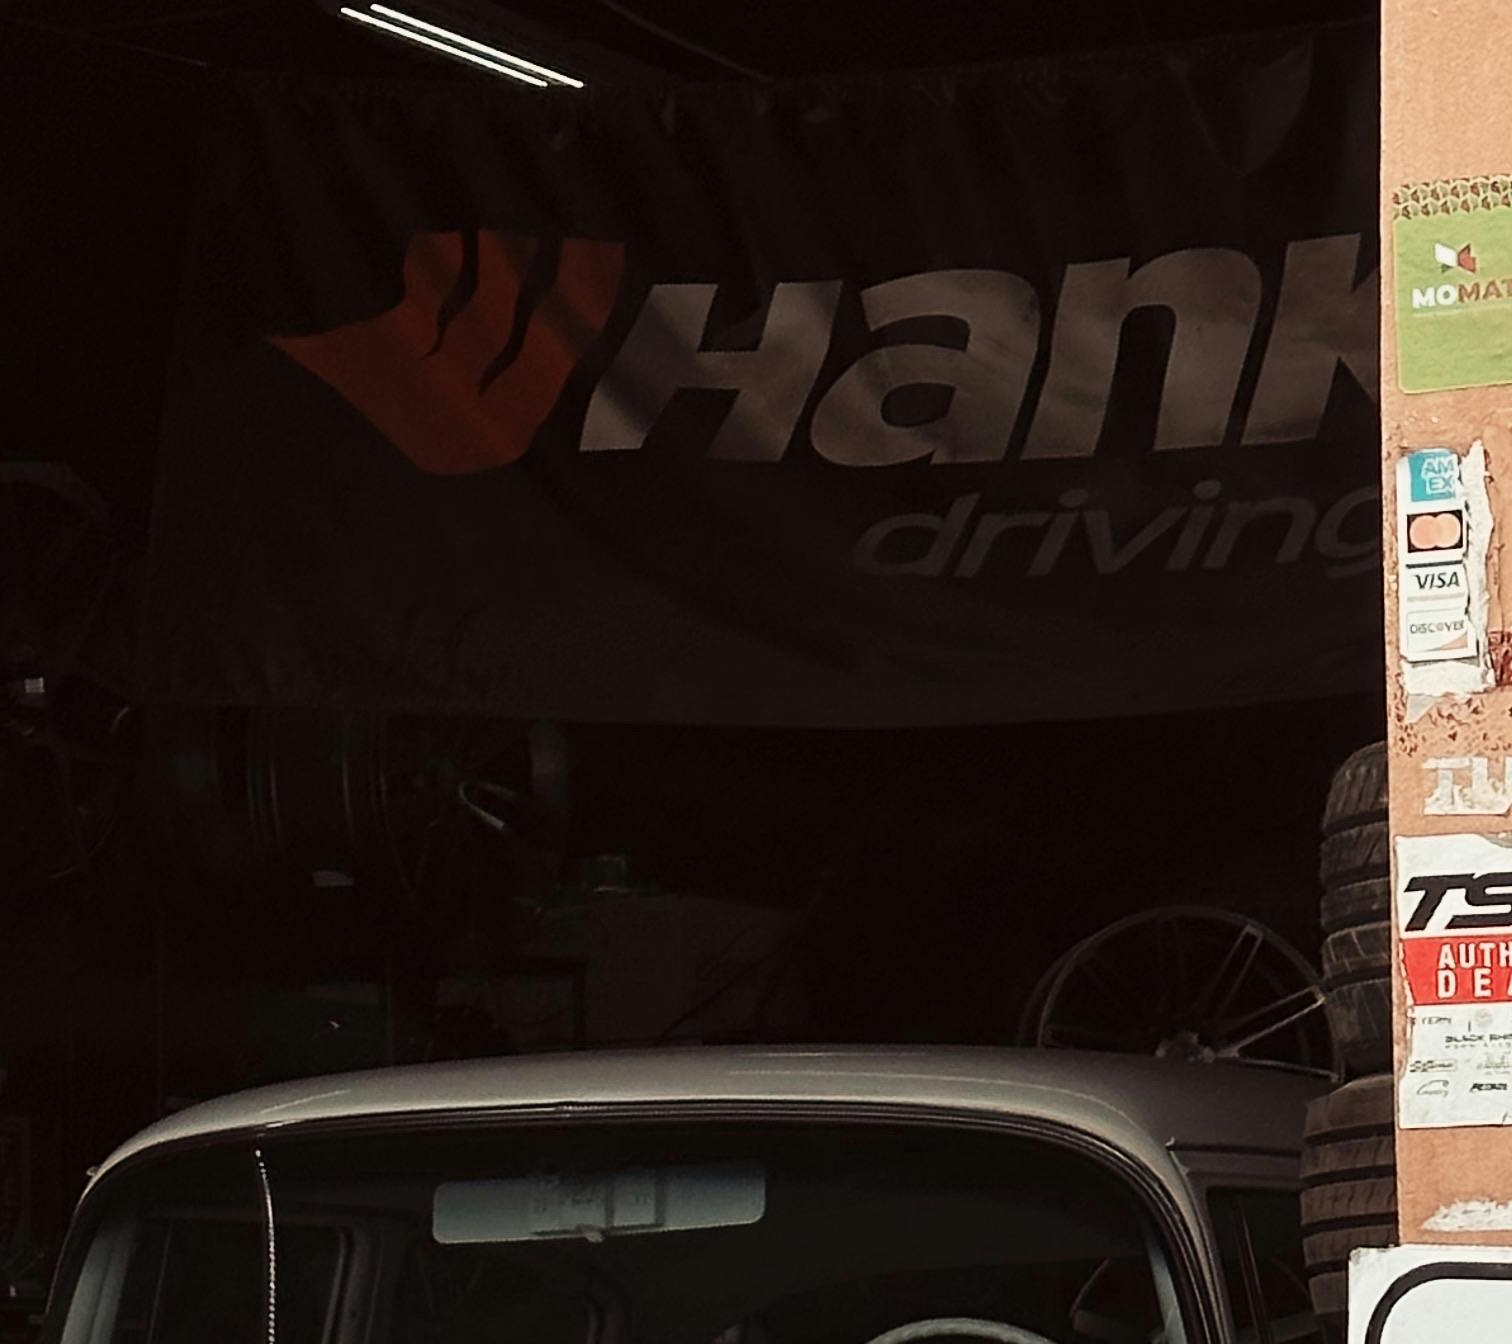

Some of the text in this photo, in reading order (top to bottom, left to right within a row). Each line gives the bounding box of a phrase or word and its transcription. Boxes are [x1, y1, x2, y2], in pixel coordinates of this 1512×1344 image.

[1415, 572, 1461, 590] VISA
[1404, 871, 1512, 932] TS
[1437, 967, 1512, 1000] DE
